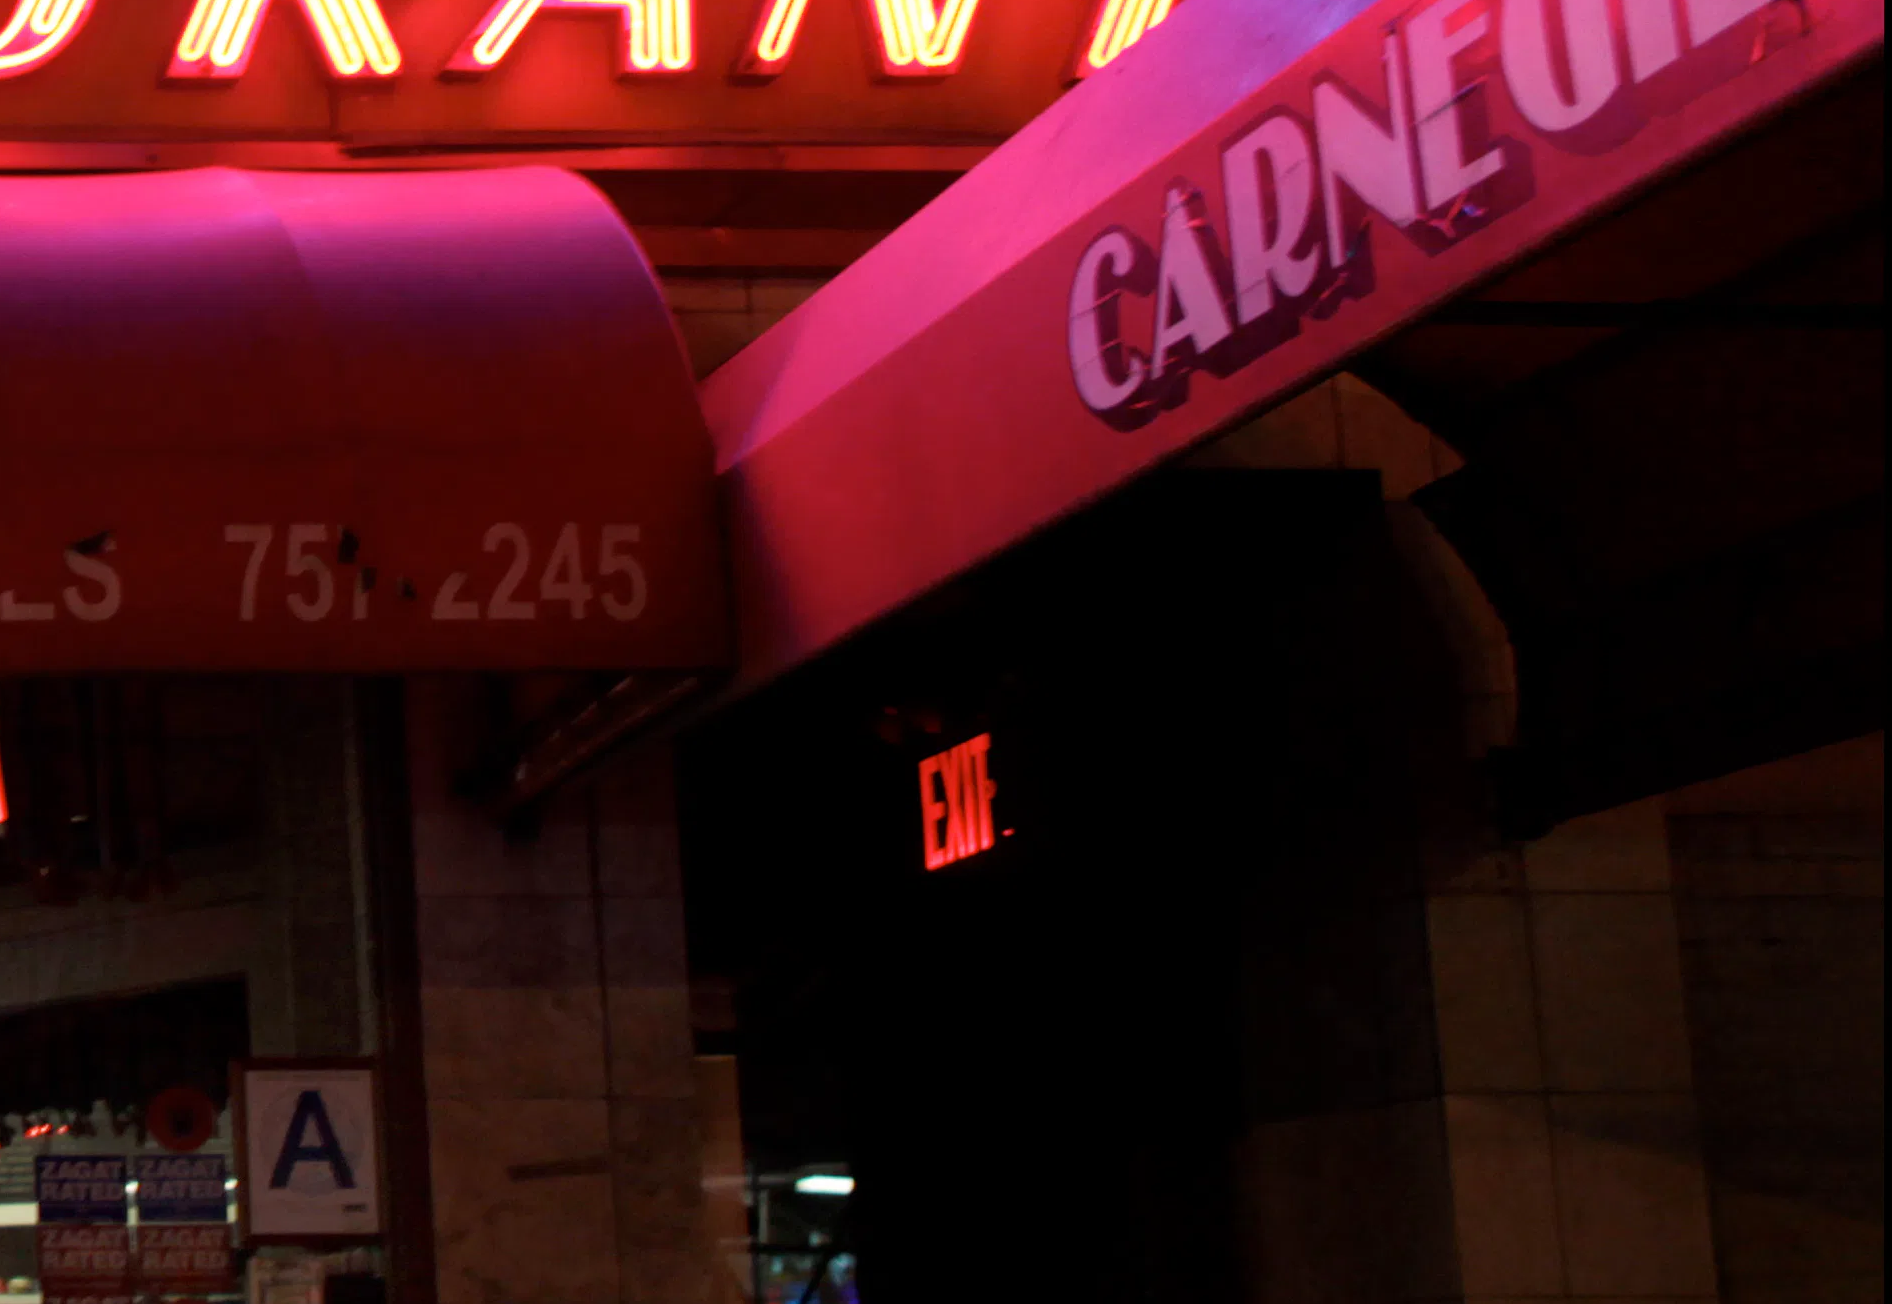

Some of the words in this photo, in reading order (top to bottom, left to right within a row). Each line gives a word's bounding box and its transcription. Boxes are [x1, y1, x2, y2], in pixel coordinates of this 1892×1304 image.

[916, 731, 997, 872] EXIT
[40, 1159, 125, 1180] ZAGAT
[269, 1090, 357, 1189] A
[40, 1181, 125, 1202] RATED
